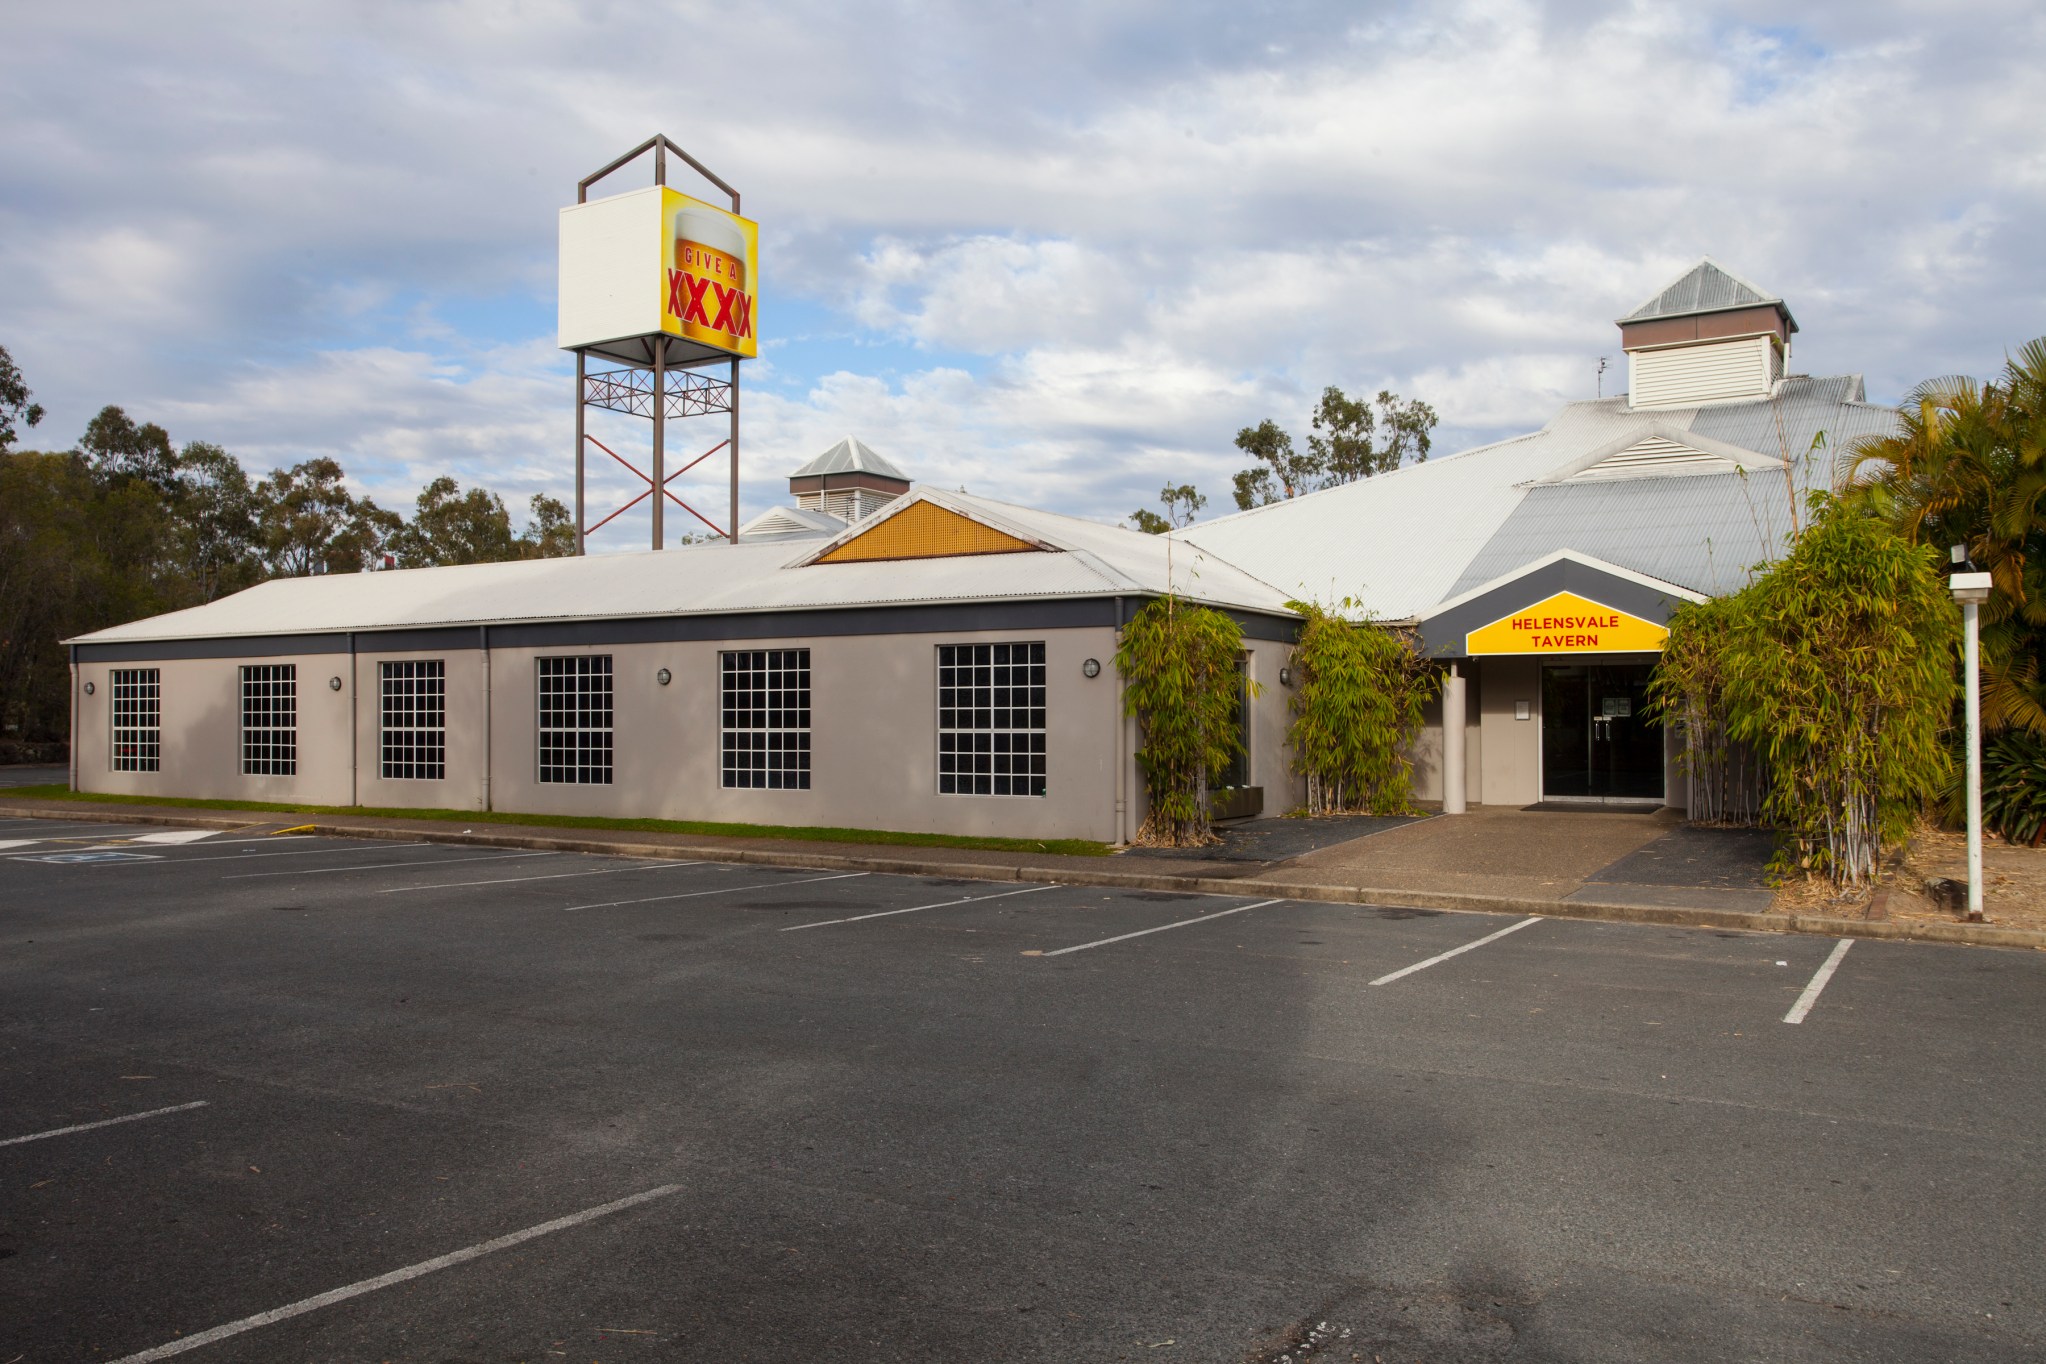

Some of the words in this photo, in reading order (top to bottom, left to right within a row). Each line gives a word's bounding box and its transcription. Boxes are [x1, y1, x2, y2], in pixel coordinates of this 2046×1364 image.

[685, 247, 722, 274] GIVE
[729, 262, 737, 280] A
[668, 267, 752, 339] XXXX
[1512, 615, 1619, 630] HELENSVALE
[1531, 634, 1598, 648] TAVERN
